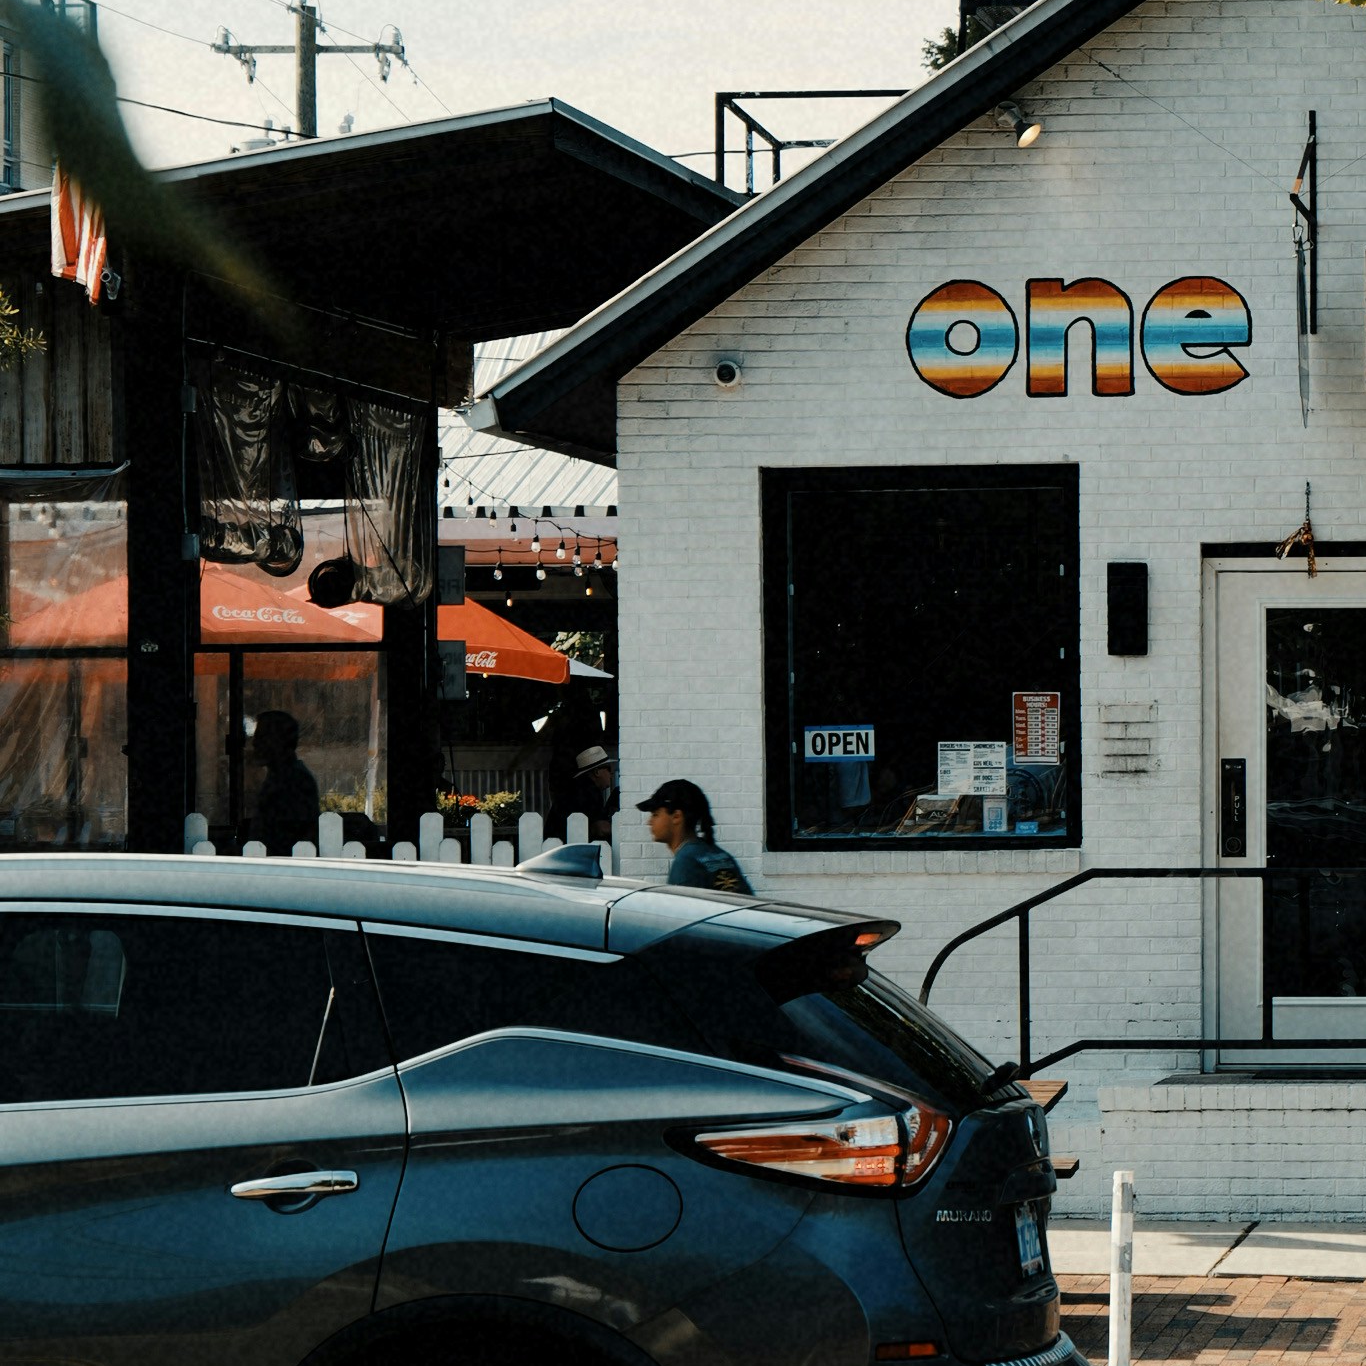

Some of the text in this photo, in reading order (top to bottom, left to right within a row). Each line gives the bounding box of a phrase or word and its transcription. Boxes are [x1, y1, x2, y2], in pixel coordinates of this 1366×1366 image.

[906, 275, 1252, 399] one
[211, 604, 307, 625] Coca-Cola
[811, 732, 869, 756] OPEN
[936, 1210, 992, 1222] MURANO
